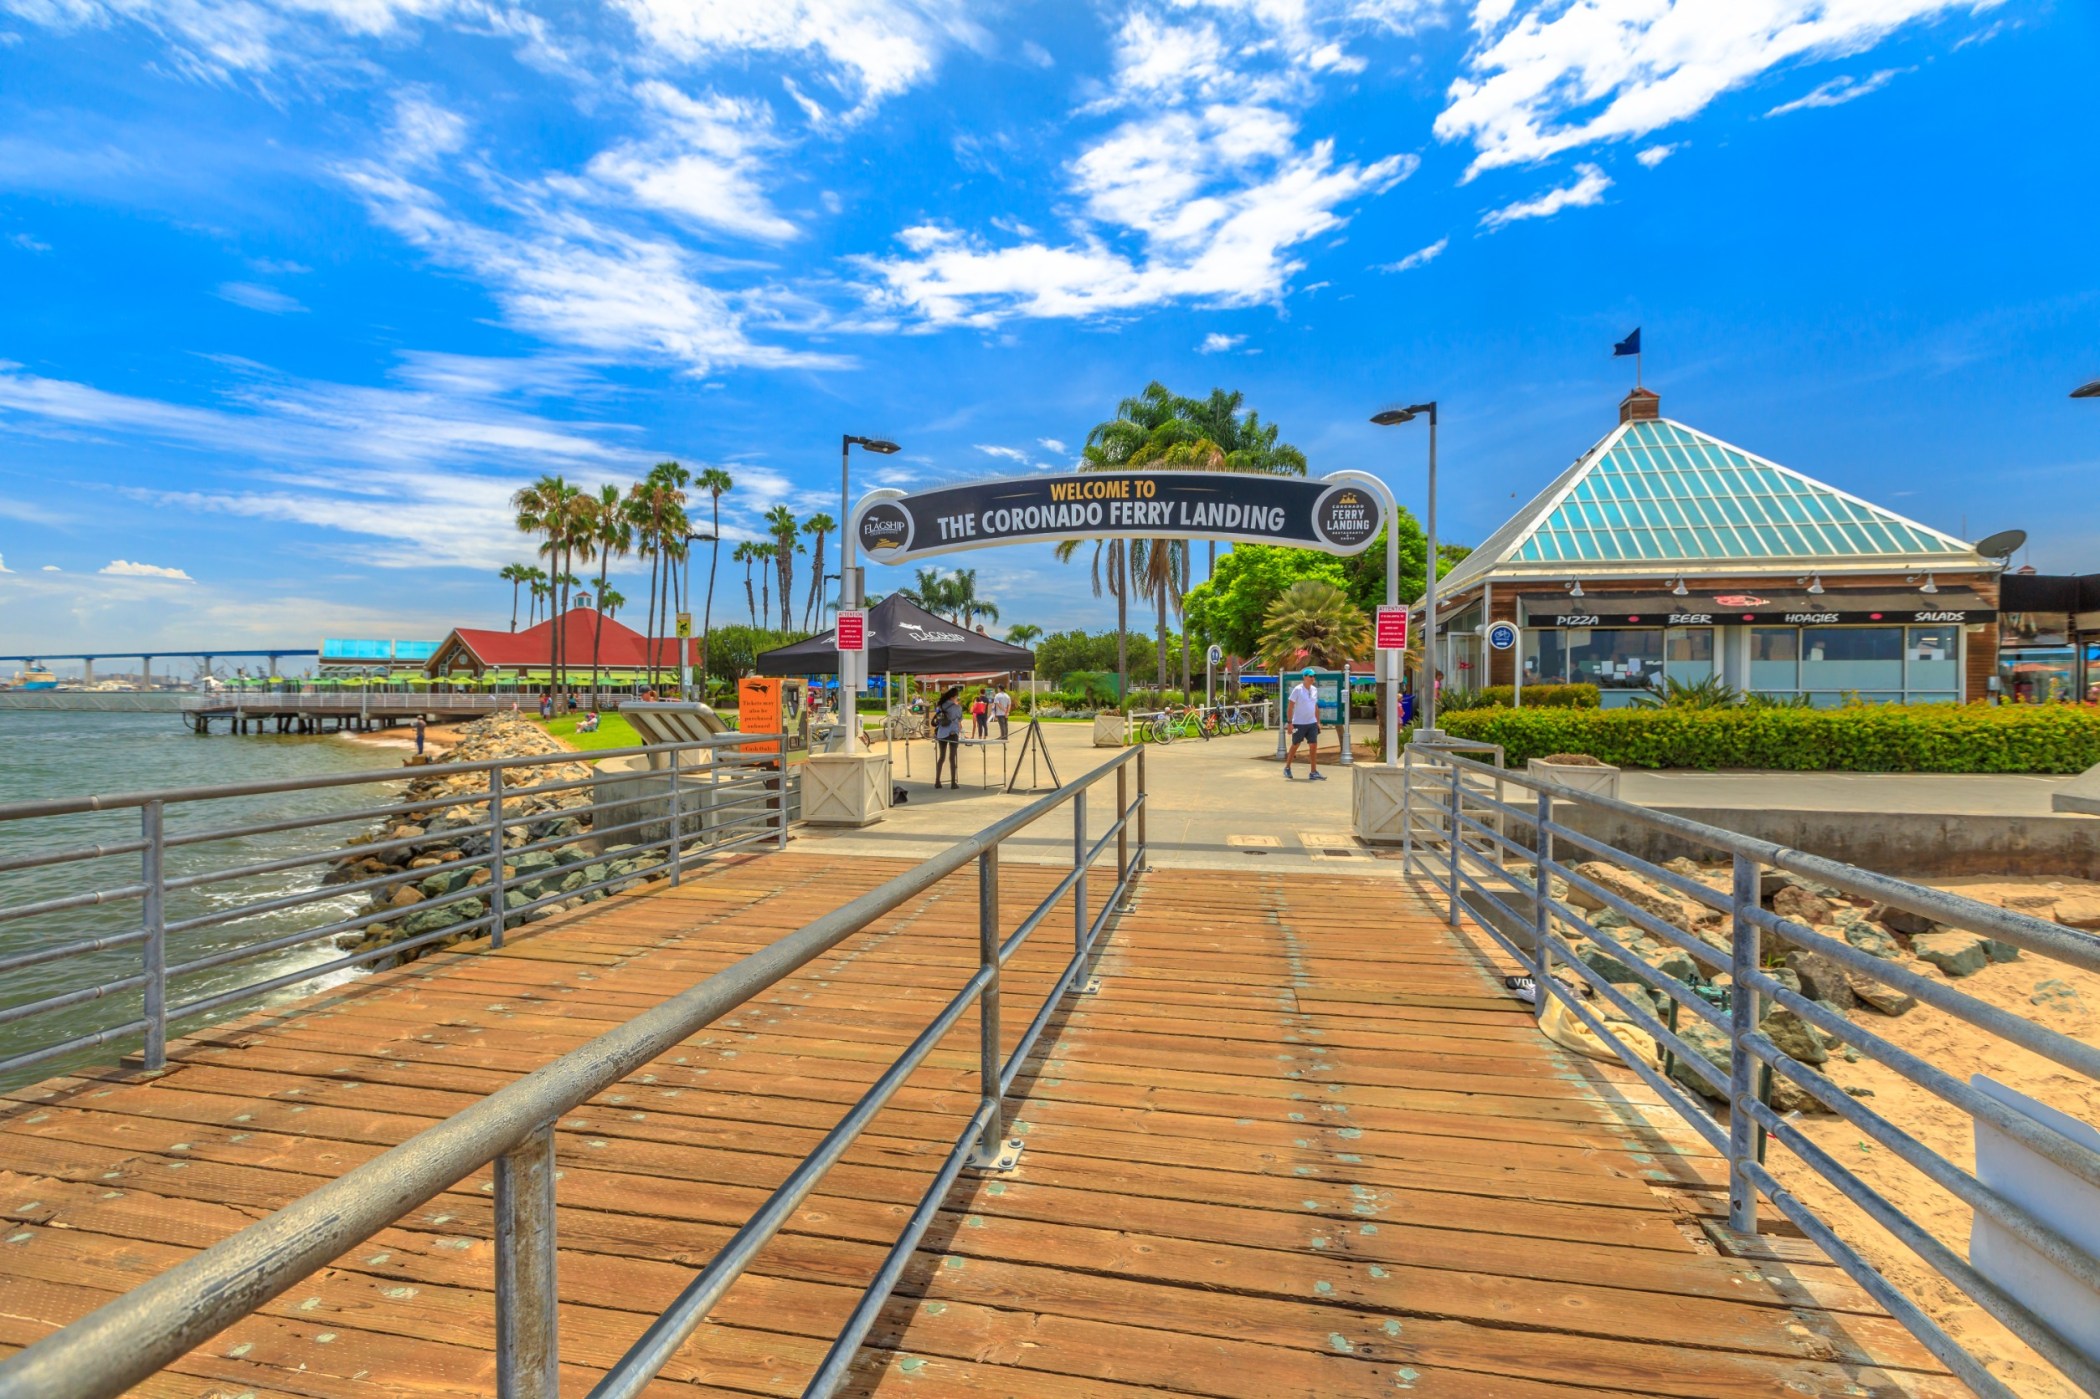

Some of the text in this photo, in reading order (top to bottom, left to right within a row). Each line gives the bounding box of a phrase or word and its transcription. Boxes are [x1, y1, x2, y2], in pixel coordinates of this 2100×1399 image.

[1050, 479, 1156, 502] WELCOME TO
[1332, 509, 1365, 520] FERRY
[937, 501, 1285, 540] THE CORONADO FERRY LANDING
[1327, 520, 1370, 530] LANDING
[864, 520, 905, 535] FLAGSHIP
[1556, 615, 1600, 626] PIZZA
[1668, 614, 1712, 624] BEER
[1784, 613, 1839, 623] HOAGIES
[1914, 611, 1965, 622] SALADS
